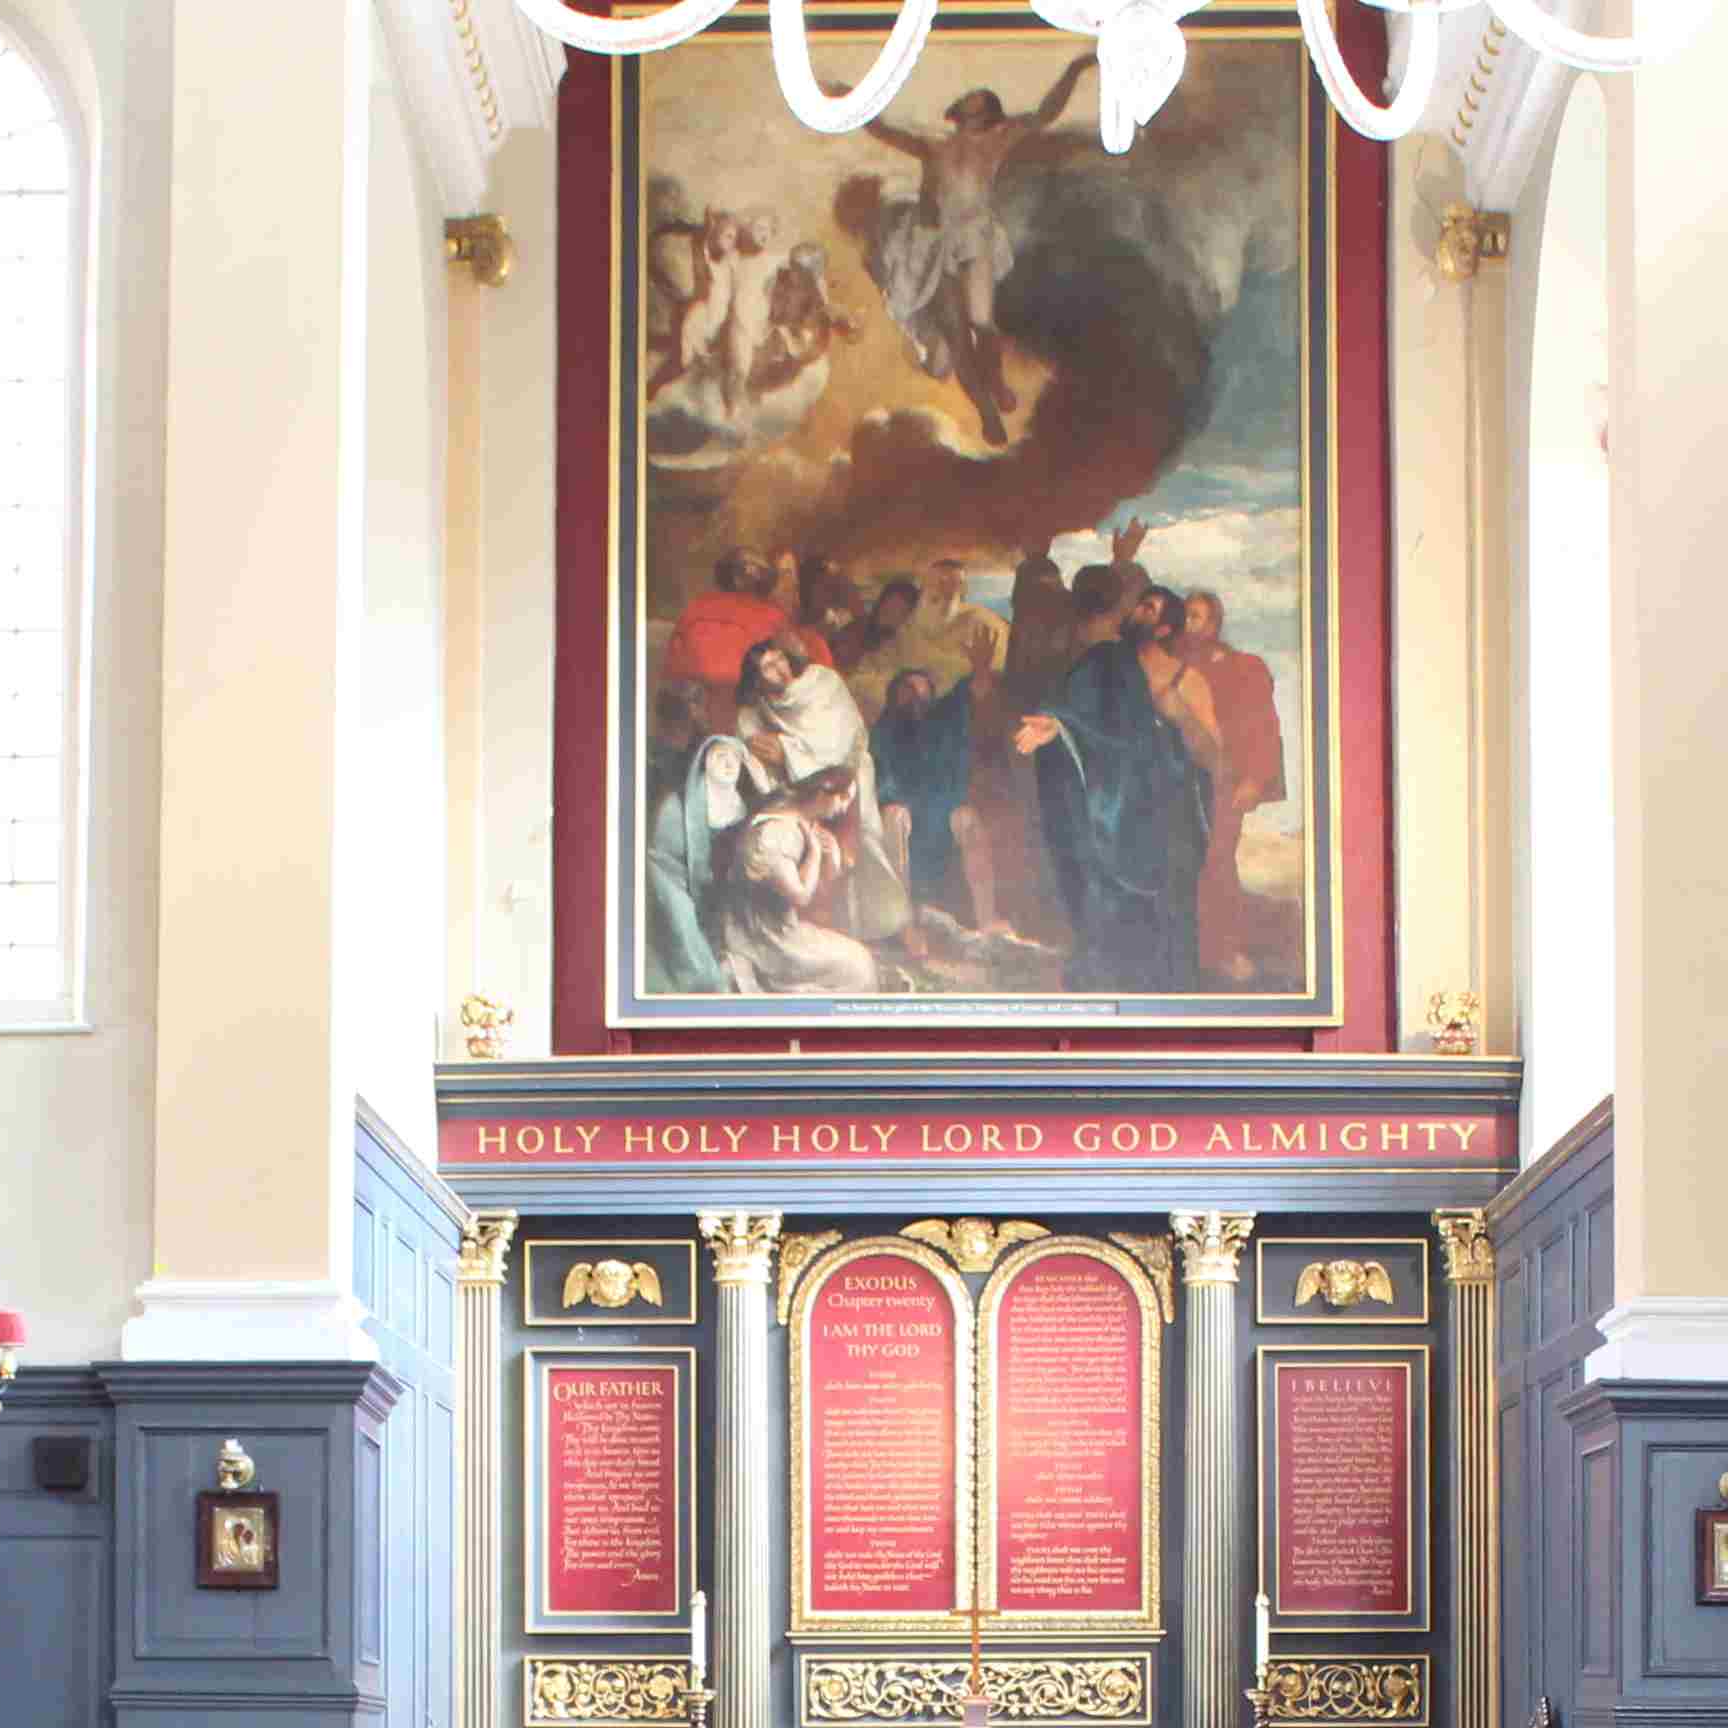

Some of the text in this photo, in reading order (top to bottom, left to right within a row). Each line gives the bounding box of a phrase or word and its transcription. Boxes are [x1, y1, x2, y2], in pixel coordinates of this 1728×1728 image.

[477, 1121, 1479, 1154] HOLY HOLY HOLY LORD GOD ALMIGHTY
[844, 1275, 918, 1291] EXODUS
[826, 1293, 882, 1312] Chapter
[830, 1323, 859, 1337] AM
[862, 1322, 896, 1337] THE
[898, 1322, 945, 1337] LORD
[847, 1343, 921, 1358] THY GOD
[553, 1380, 665, 1401] OUR FATHER
